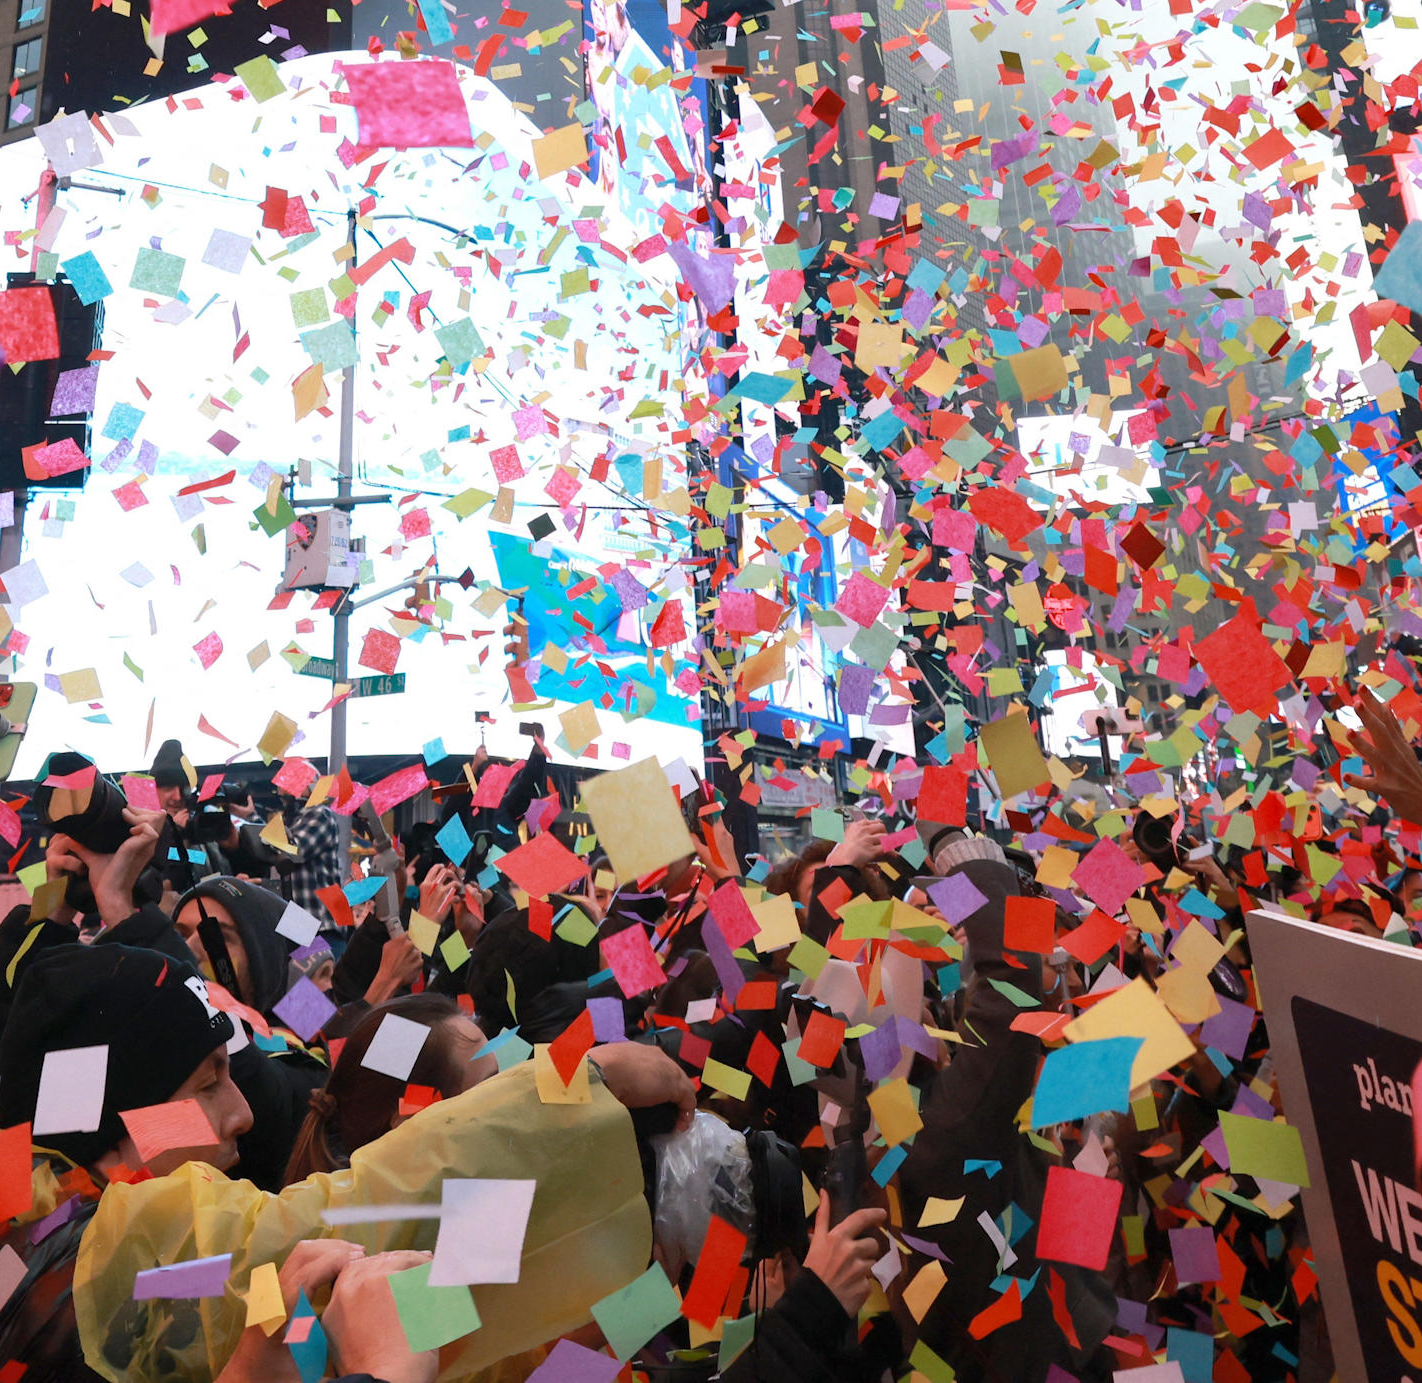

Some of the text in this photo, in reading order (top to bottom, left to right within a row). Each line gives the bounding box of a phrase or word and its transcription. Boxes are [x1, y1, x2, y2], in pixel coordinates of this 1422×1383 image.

[362, 679, 373, 695] W
[377, 676, 393, 693] 46
[1353, 1057, 1414, 1116] plan
